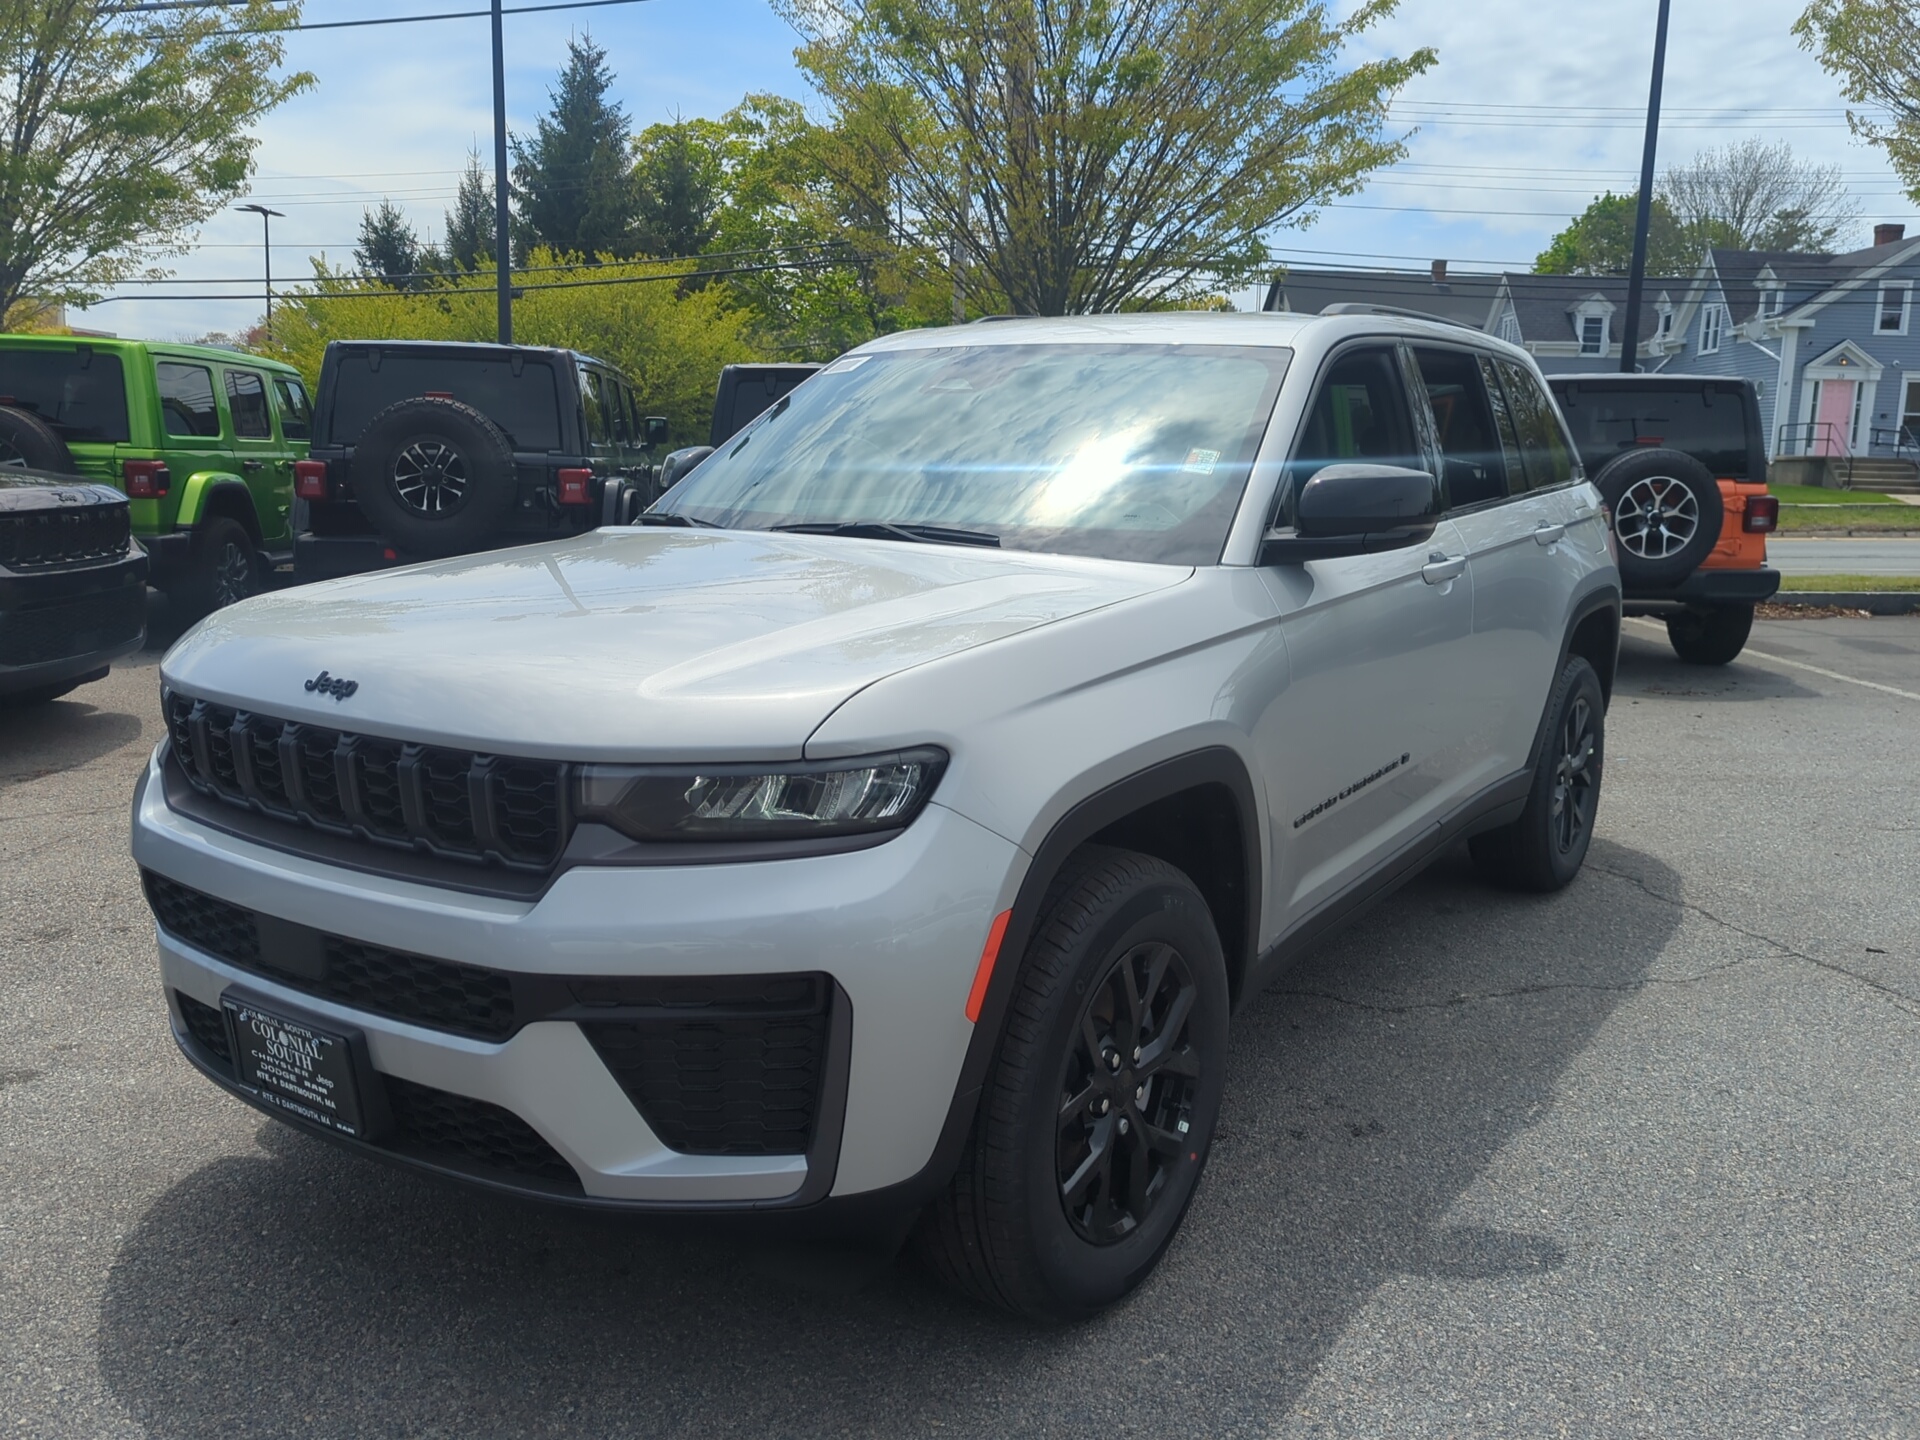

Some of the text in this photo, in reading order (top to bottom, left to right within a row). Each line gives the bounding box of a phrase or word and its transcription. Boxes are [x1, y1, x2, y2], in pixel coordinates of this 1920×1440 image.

[304, 671, 359, 701] Jeep
[251, 1019, 323, 1060] COLONIAL
[284, 1023, 313, 1039] SOUTH
[251, 1049, 334, 1089] CHRYSLER Jeep
[266, 1040, 313, 1071] SOUTH
[260, 1061, 328, 1095] DODGE RAM
[272, 1076, 278, 1085] 6
[280, 1079, 325, 1106] DARTMOUTH,
[324, 1098, 337, 1110] MA
[320, 1114, 332, 1126] MA
